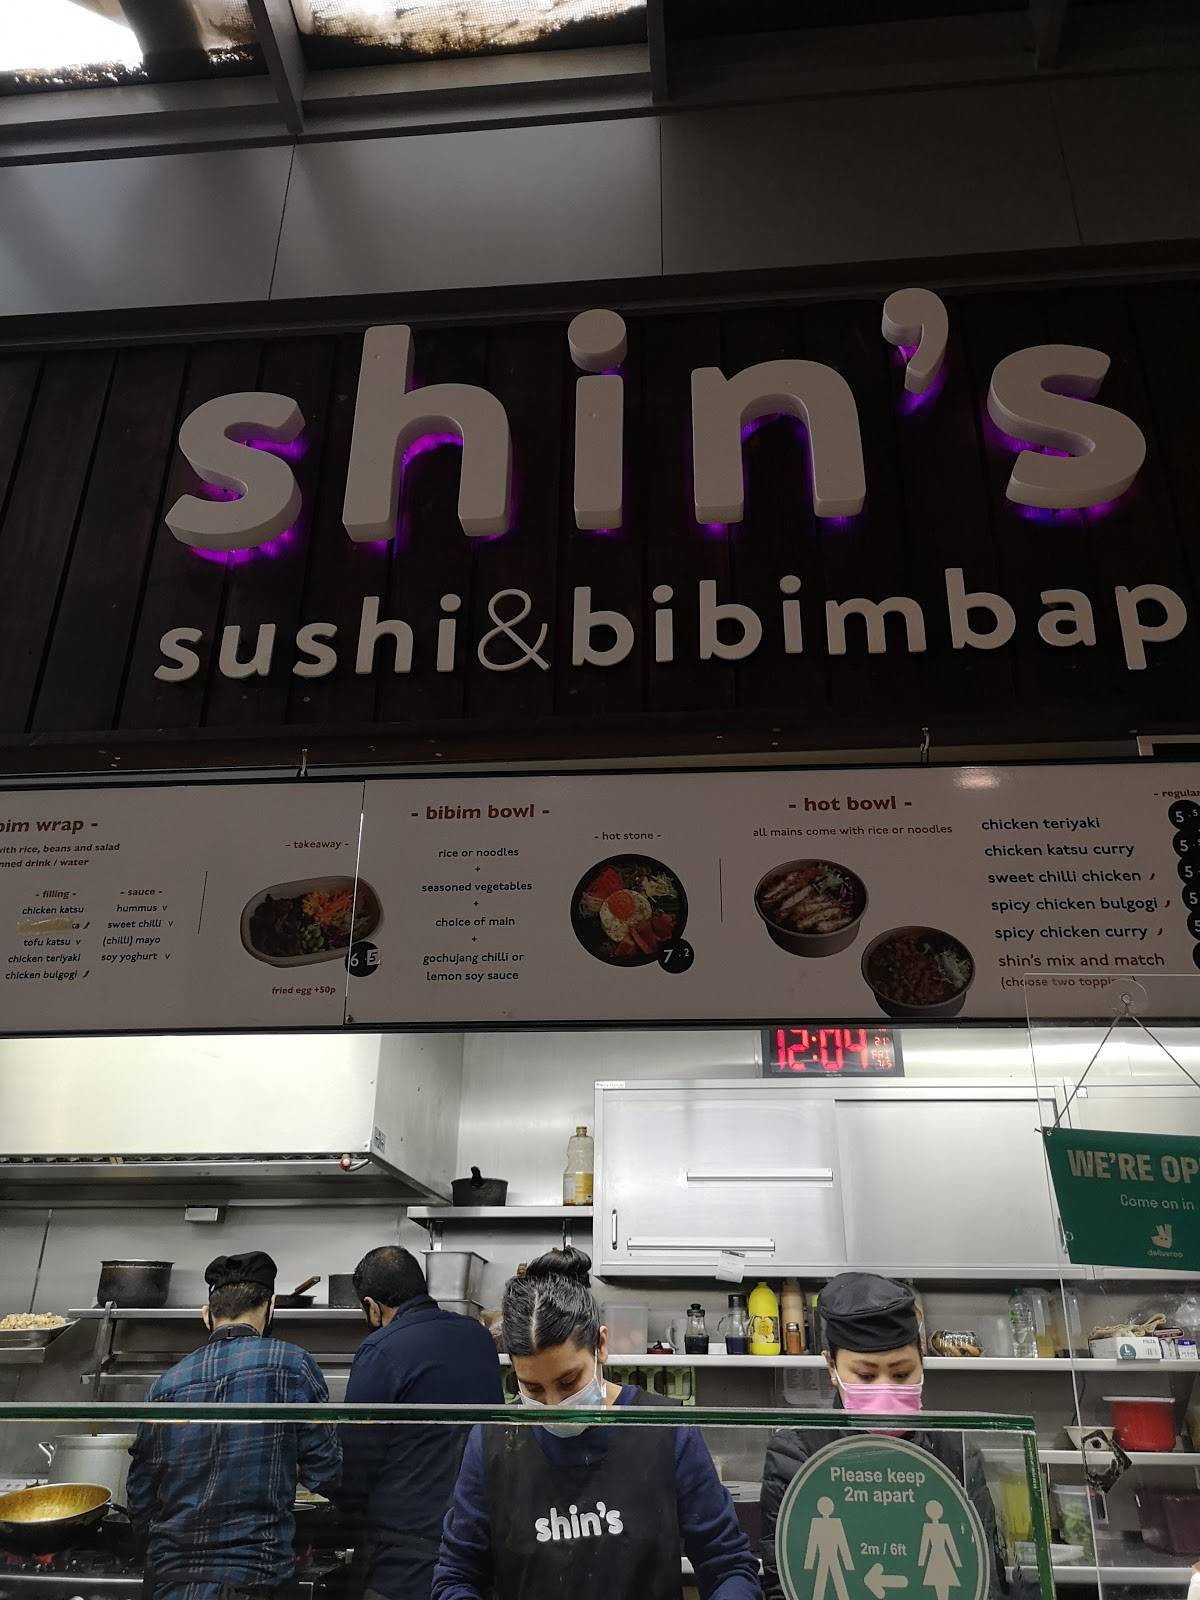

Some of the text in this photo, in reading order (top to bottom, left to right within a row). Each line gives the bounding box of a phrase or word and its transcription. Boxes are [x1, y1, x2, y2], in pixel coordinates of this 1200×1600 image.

[165, 287, 1147, 549] shin's
[803, 797, 841, 812] hot
[846, 795, 897, 811] bowl
[425, 805, 481, 820] bibim
[487, 803, 535, 819] bowl
[35, 820, 85, 835] wrap
[753, 827, 768, 837] all
[770, 827, 803, 837] mains
[805, 828, 837, 836] come
[839, 825, 865, 835] with
[867, 826, 889, 835] rice
[907, 824, 953, 834] noodles
[981, 816, 1101, 833] chicken teriyaki
[602, 831, 621, 841] hot
[623, 831, 654, 841] stone
[18, 846, 41, 854] rice,
[42, 844, 72, 853] beans
[73, 843, 93, 852] and
[94, 842, 121, 851] salad
[293, 839, 342, 850] takeaway
[984, 843, 1135, 858] chicken katsu curry
[438, 848, 459, 858] rice
[476, 847, 520, 857] noodles
[24, 858, 51, 868] drink
[987, 869, 1142, 884] sweet chilli chicken
[421, 880, 533, 894] seasoned vegetables
[42, 889, 71, 900] filling
[21, 905, 85, 915] chicken katsu
[116, 903, 158, 913] hummus
[991, 896, 1158, 915] spicy chicken bulgogi
[107, 920, 137, 929] sweet
[138, 919, 162, 928] chilli
[435, 916, 516, 927] choice of main
[994, 925, 1148, 942] spicy chicken curry
[23, 937, 44, 947] tofu
[45, 937, 71, 946] katsu
[102, 935, 161, 948] (chilli) mayo
[7, 953, 81, 965] chicken teriyaki
[100, 954, 118, 964] soy
[118, 951, 158, 964] yoghurt
[422, 951, 525, 966] gochujang chilli or
[998, 952, 1165, 967] shin's mix and match
[4, 968, 78, 981] chicken bulgogi
[426, 971, 519, 983] lemon soy sauce
[1052, 978, 1076, 987] two
[271, 985, 336, 996] fried egg +50p
[776, 1028, 869, 1071] 12:04
[1066, 1149, 1155, 1183] WE'RE
[1120, 1194, 1196, 1210] Come on in
[830, 1466, 925, 1486] Please keep
[843, 1486, 915, 1505] 2m apart
[534, 1501, 625, 1542] shin's
[860, 1543, 880, 1556] 2m
[890, 1543, 907, 1556] 6ft
